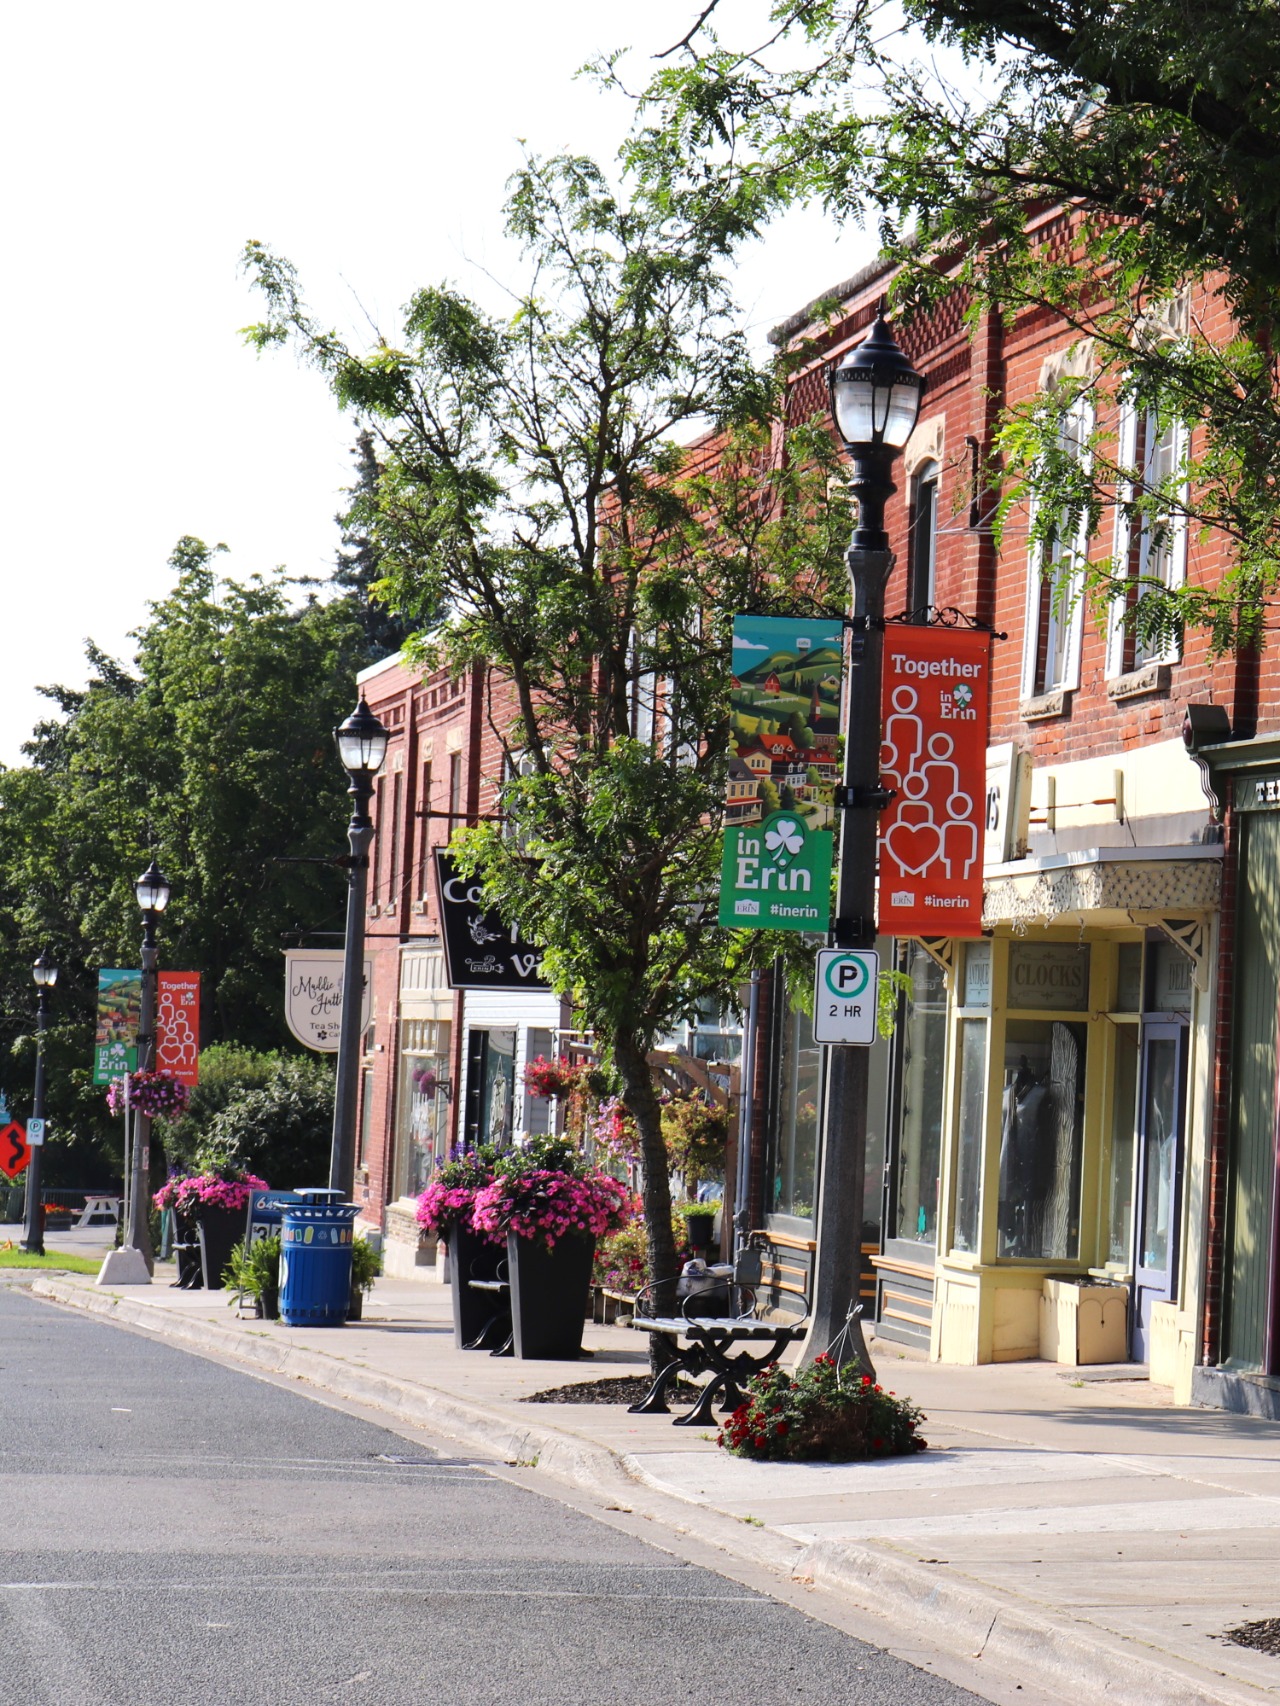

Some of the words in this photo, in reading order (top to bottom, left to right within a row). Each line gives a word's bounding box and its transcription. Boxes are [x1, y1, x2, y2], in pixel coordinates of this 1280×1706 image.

[891, 654, 982, 679] Together
[940, 690, 952, 702] in
[940, 702, 976, 720] Erin
[738, 831, 760, 855] in
[735, 857, 811, 892] Erin
[924, 894, 969, 908] #inerin
[770, 903, 818, 918] #inerin
[838, 965, 858, 988] P
[1014, 963, 1082, 987] CLOCKS
[161, 981, 197, 991] Together
[829, 1004, 838, 1017] 2
[844, 1005, 861, 1018] HR
[310, 1022, 325, 1030] Tea
[327, 1022, 341, 1030] Sh
[98, 1057, 128, 1071] Erin
